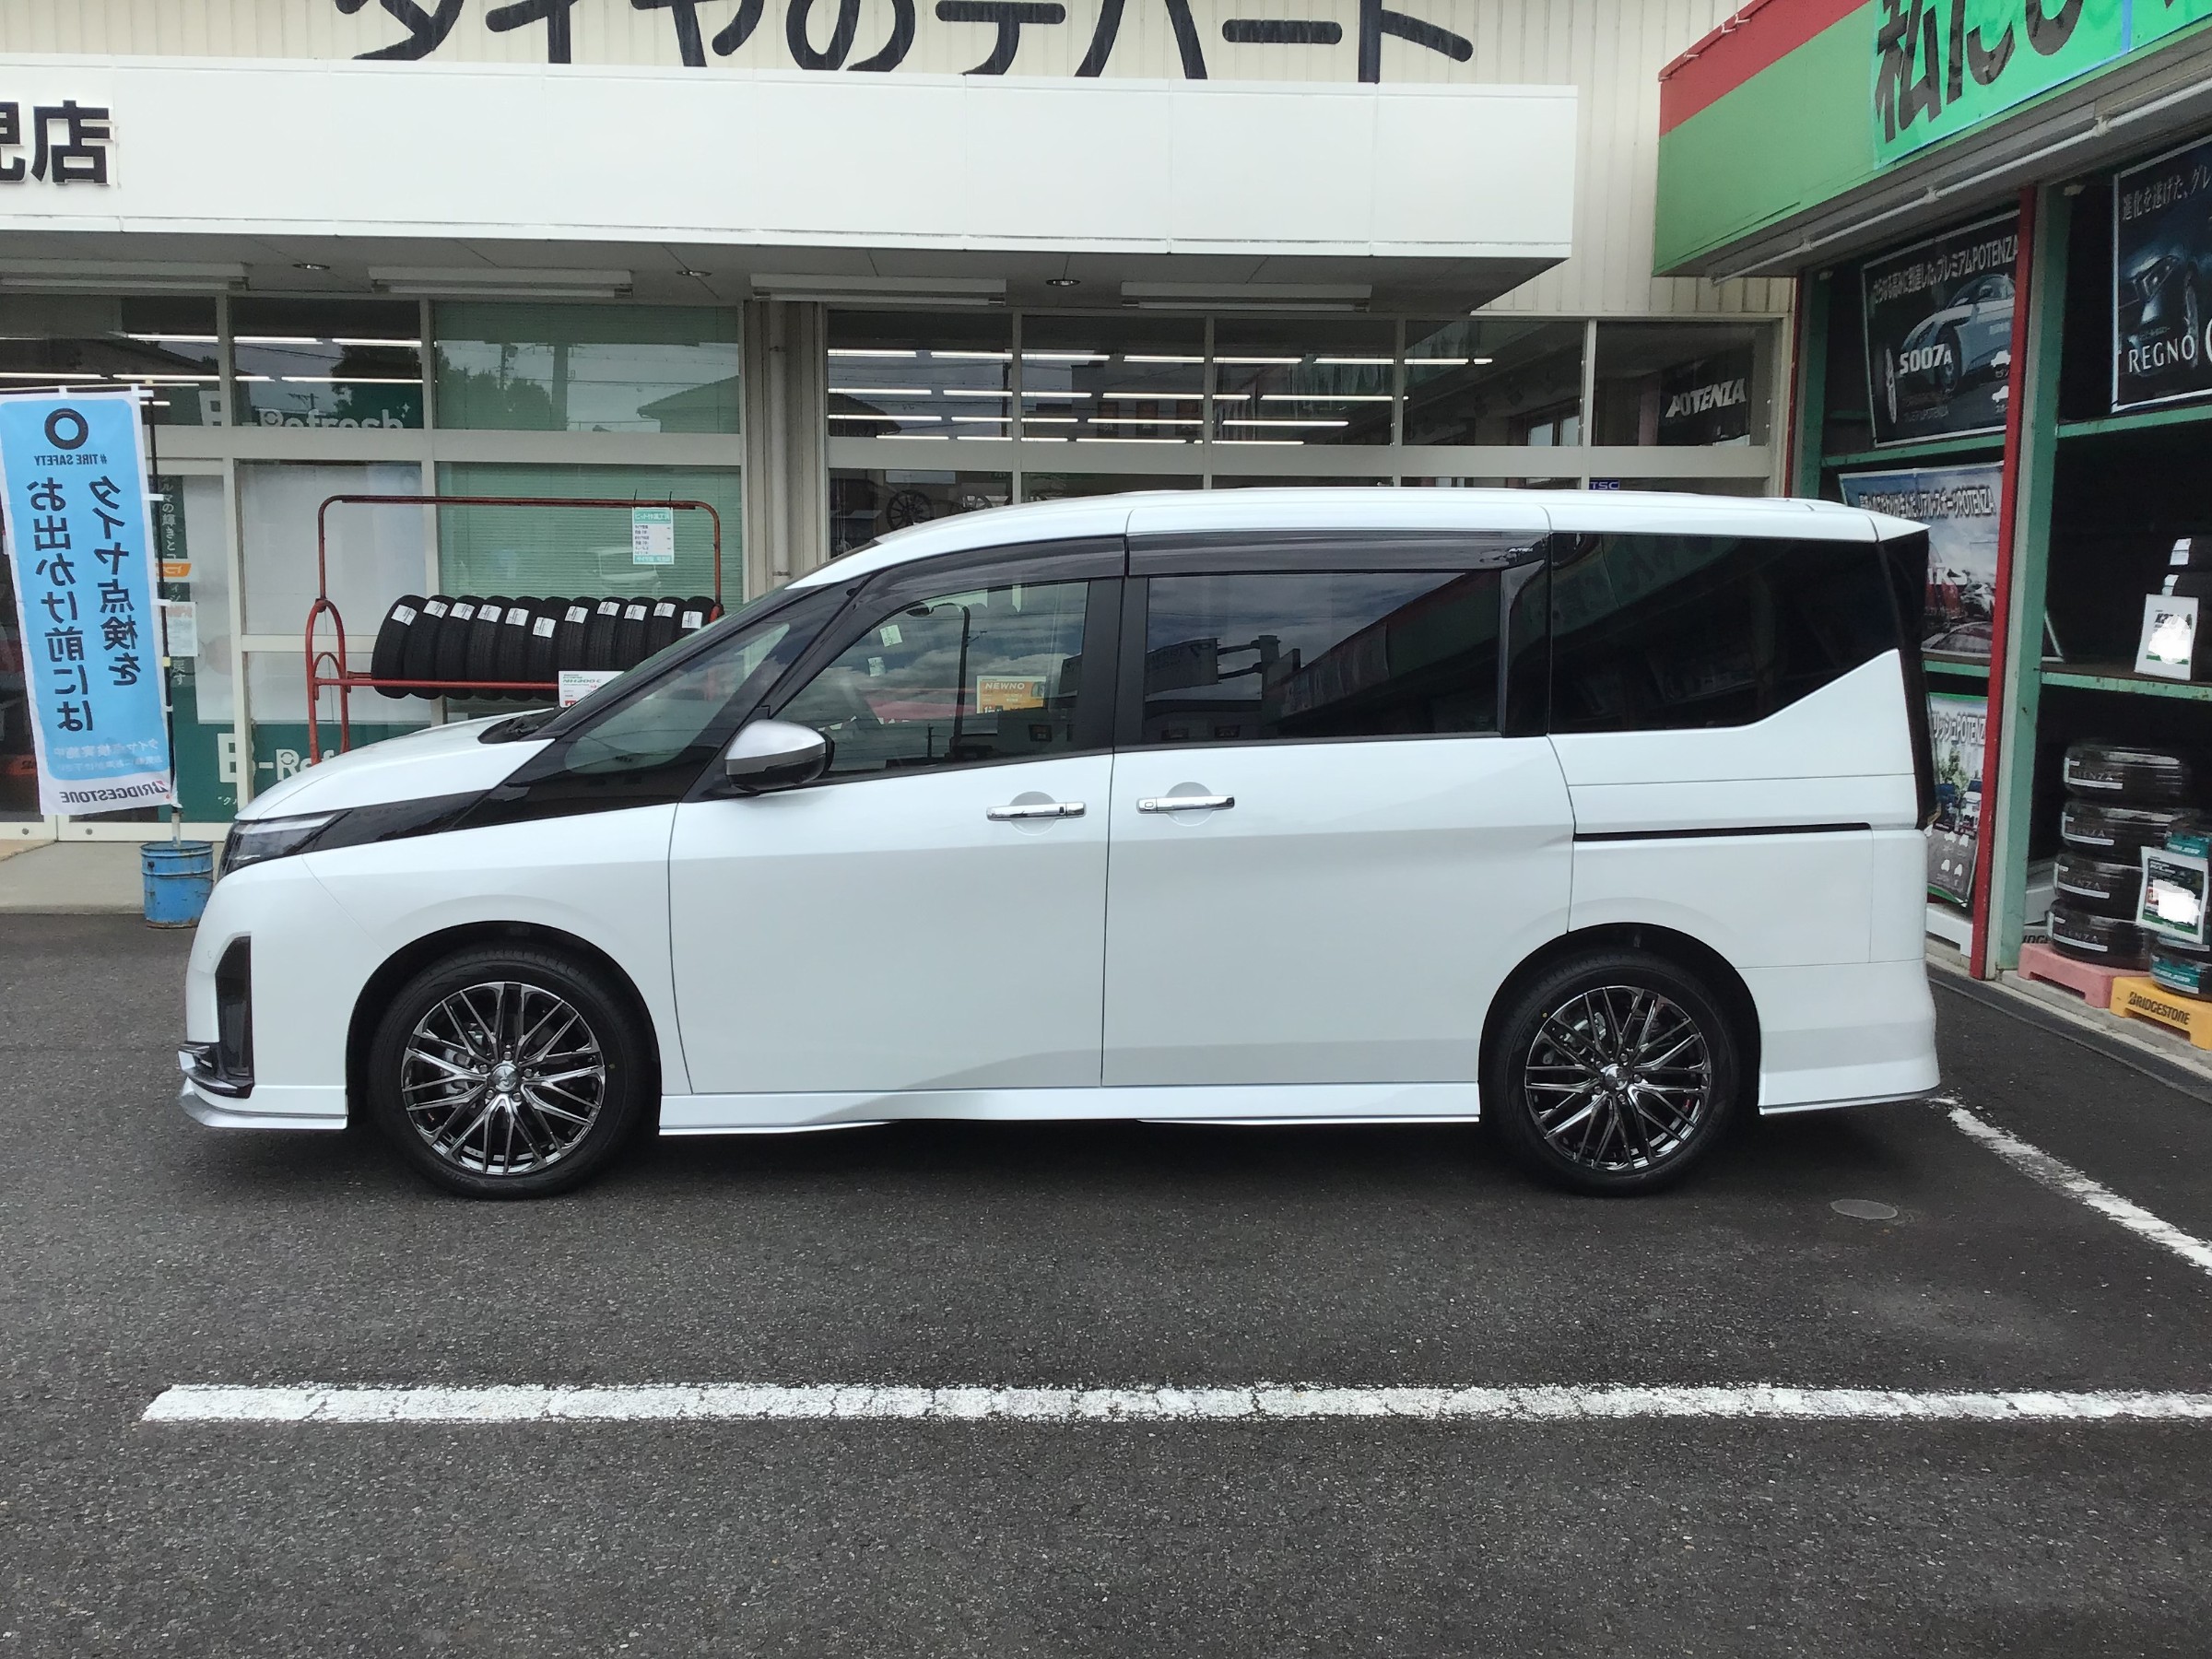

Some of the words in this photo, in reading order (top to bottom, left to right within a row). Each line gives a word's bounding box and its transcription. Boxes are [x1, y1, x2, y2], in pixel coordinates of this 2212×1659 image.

[1900, 343, 1953, 375] S007A
[2128, 334, 2195, 373] REGNO
[1665, 378, 1747, 418] POTENZA
[1591, 481, 1618, 490] TSC
[985, 682, 1025, 690] NEWNO
[2128, 991, 2191, 1026] BRIDGESTONE
